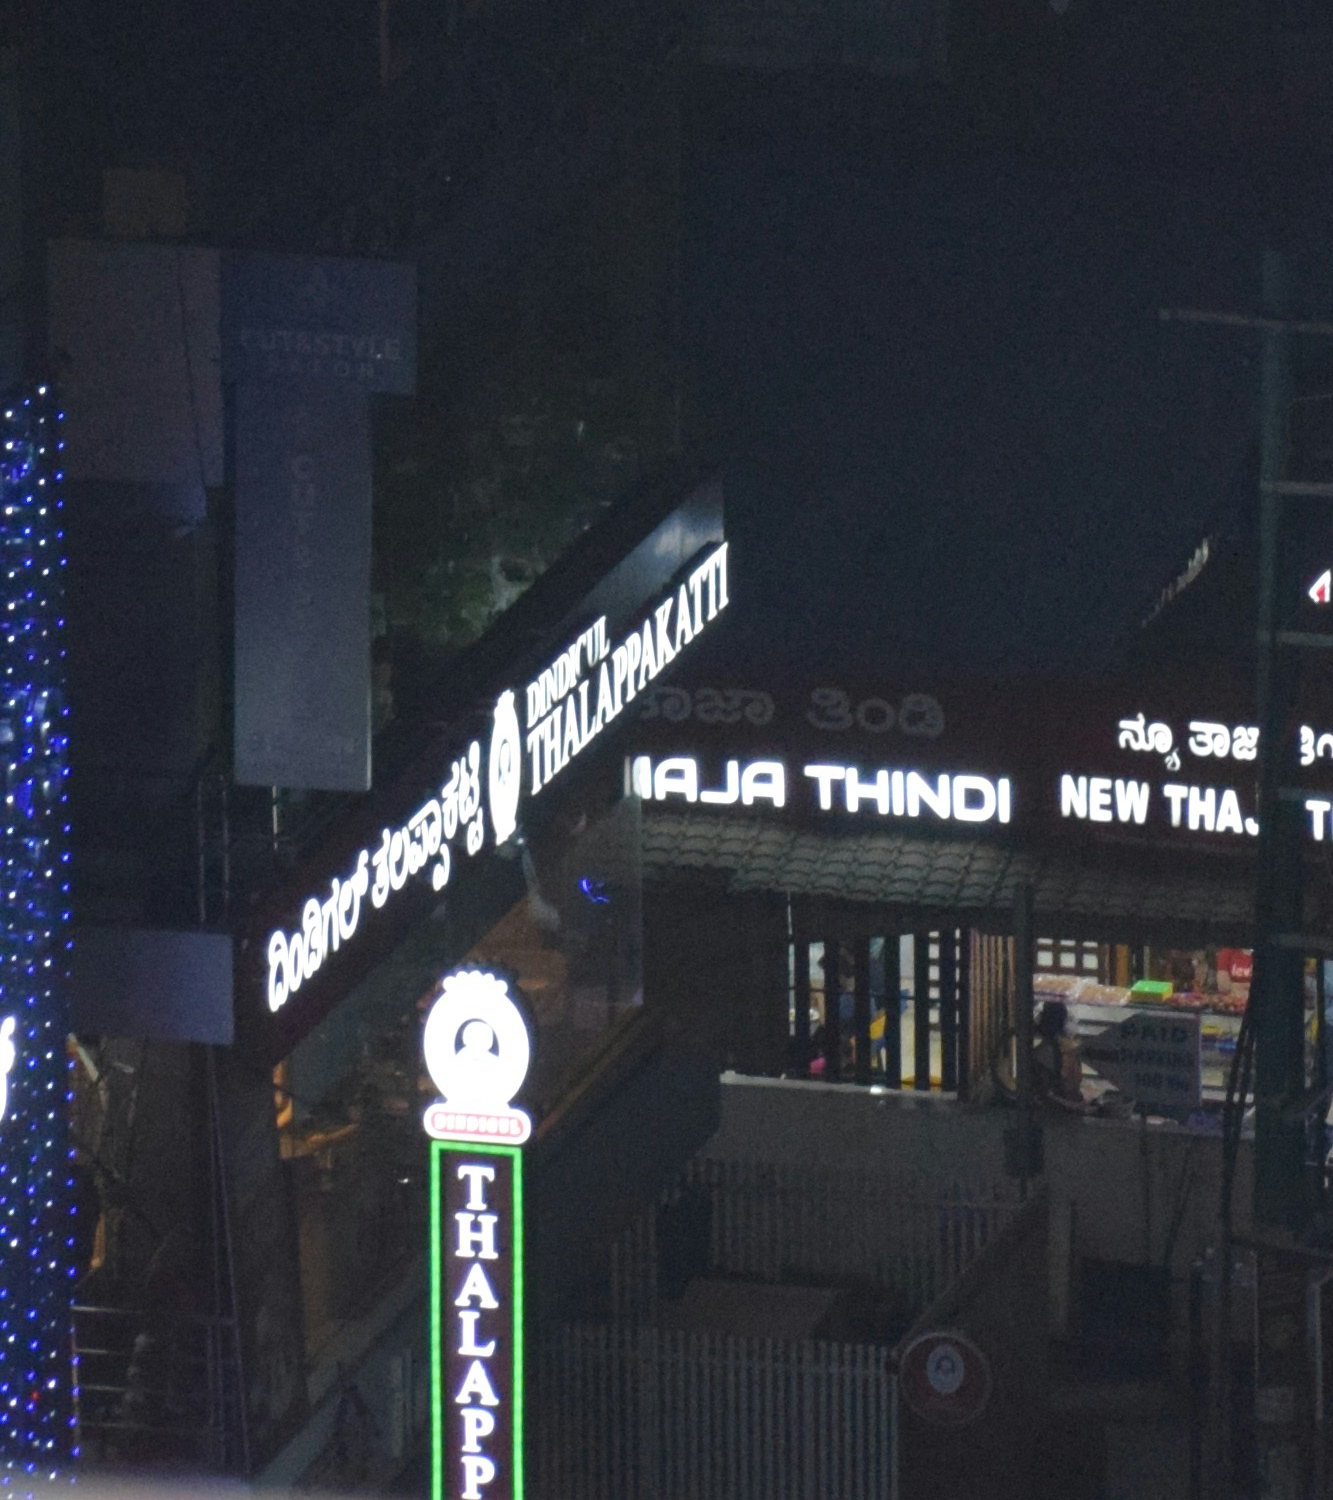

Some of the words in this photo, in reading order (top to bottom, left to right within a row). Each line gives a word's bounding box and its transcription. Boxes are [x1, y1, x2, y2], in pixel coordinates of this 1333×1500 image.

[526, 542, 729, 797] THALAPPAKATTI
[803, 763, 1011, 824] THINDI
[1060, 773, 1150, 826] NEW
